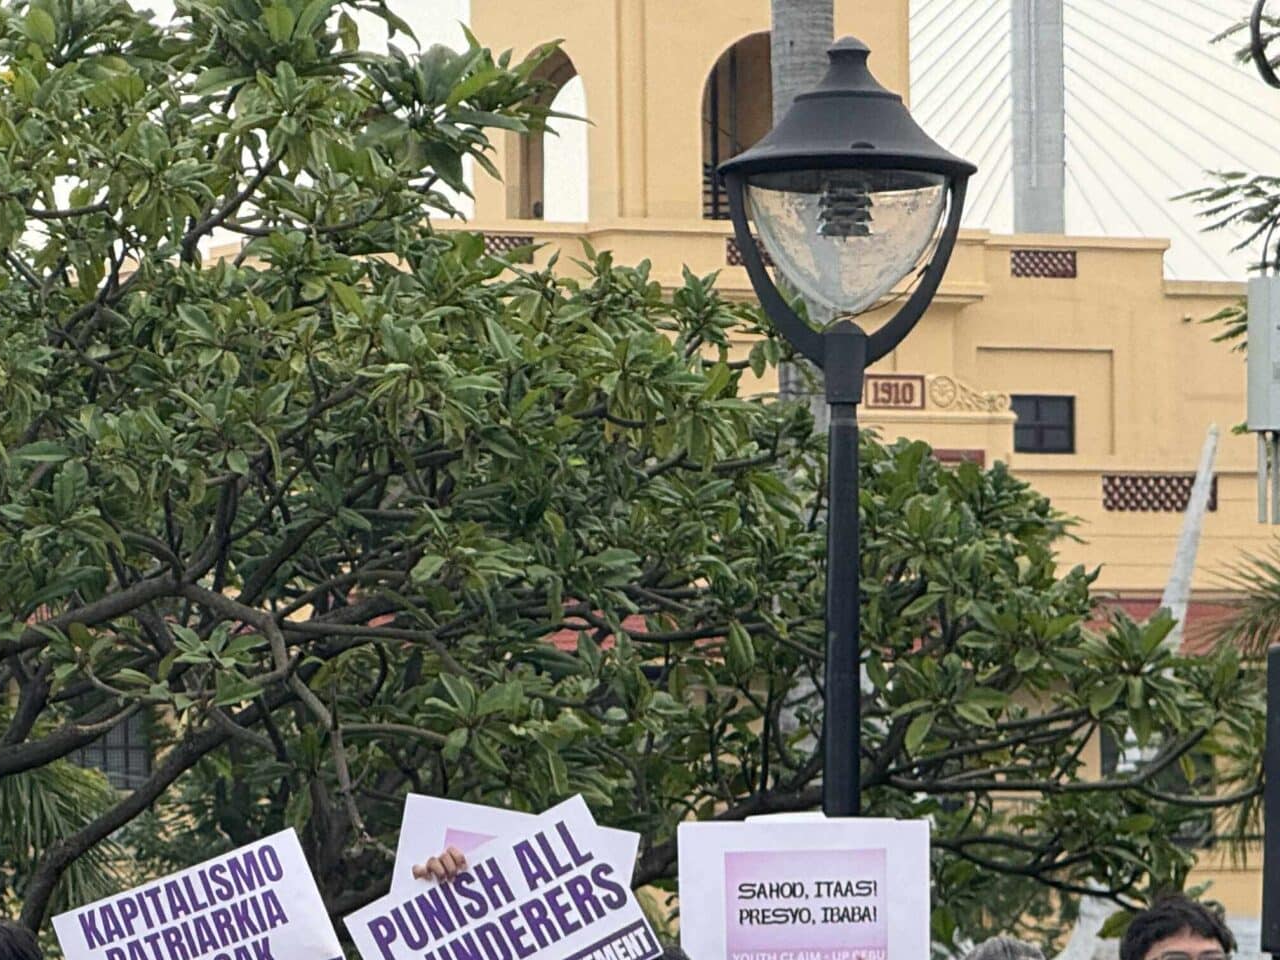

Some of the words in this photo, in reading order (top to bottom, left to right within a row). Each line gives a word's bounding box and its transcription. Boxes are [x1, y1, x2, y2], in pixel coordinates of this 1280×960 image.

[873, 381, 914, 404] 1910
[511, 820, 594, 892] ALL
[78, 844, 284, 950] KAPITALISMO
[738, 881, 809, 900] SAHOD,
[814, 880, 878, 899] ITAAS!
[739, 907, 816, 926] PRESYO,
[821, 906, 878, 924] IBABA!
